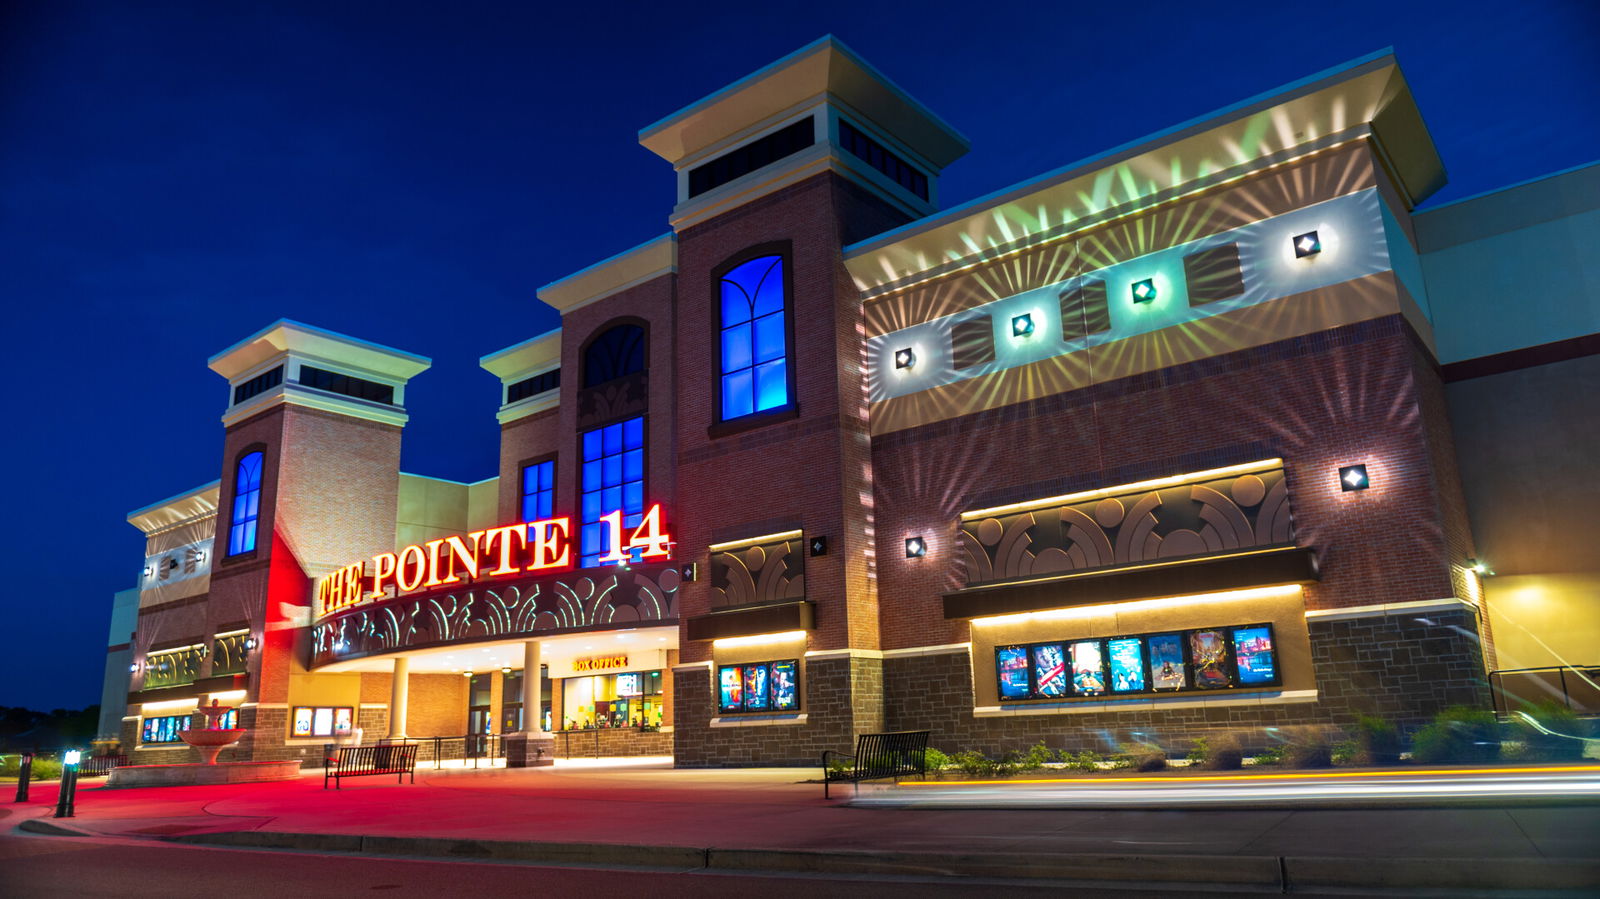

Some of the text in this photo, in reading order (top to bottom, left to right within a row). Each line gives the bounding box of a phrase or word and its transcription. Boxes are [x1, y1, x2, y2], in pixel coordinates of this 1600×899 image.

[319, 503, 671, 616] THE POINTE 14
[572, 656, 627, 671] BOX OFFICE
